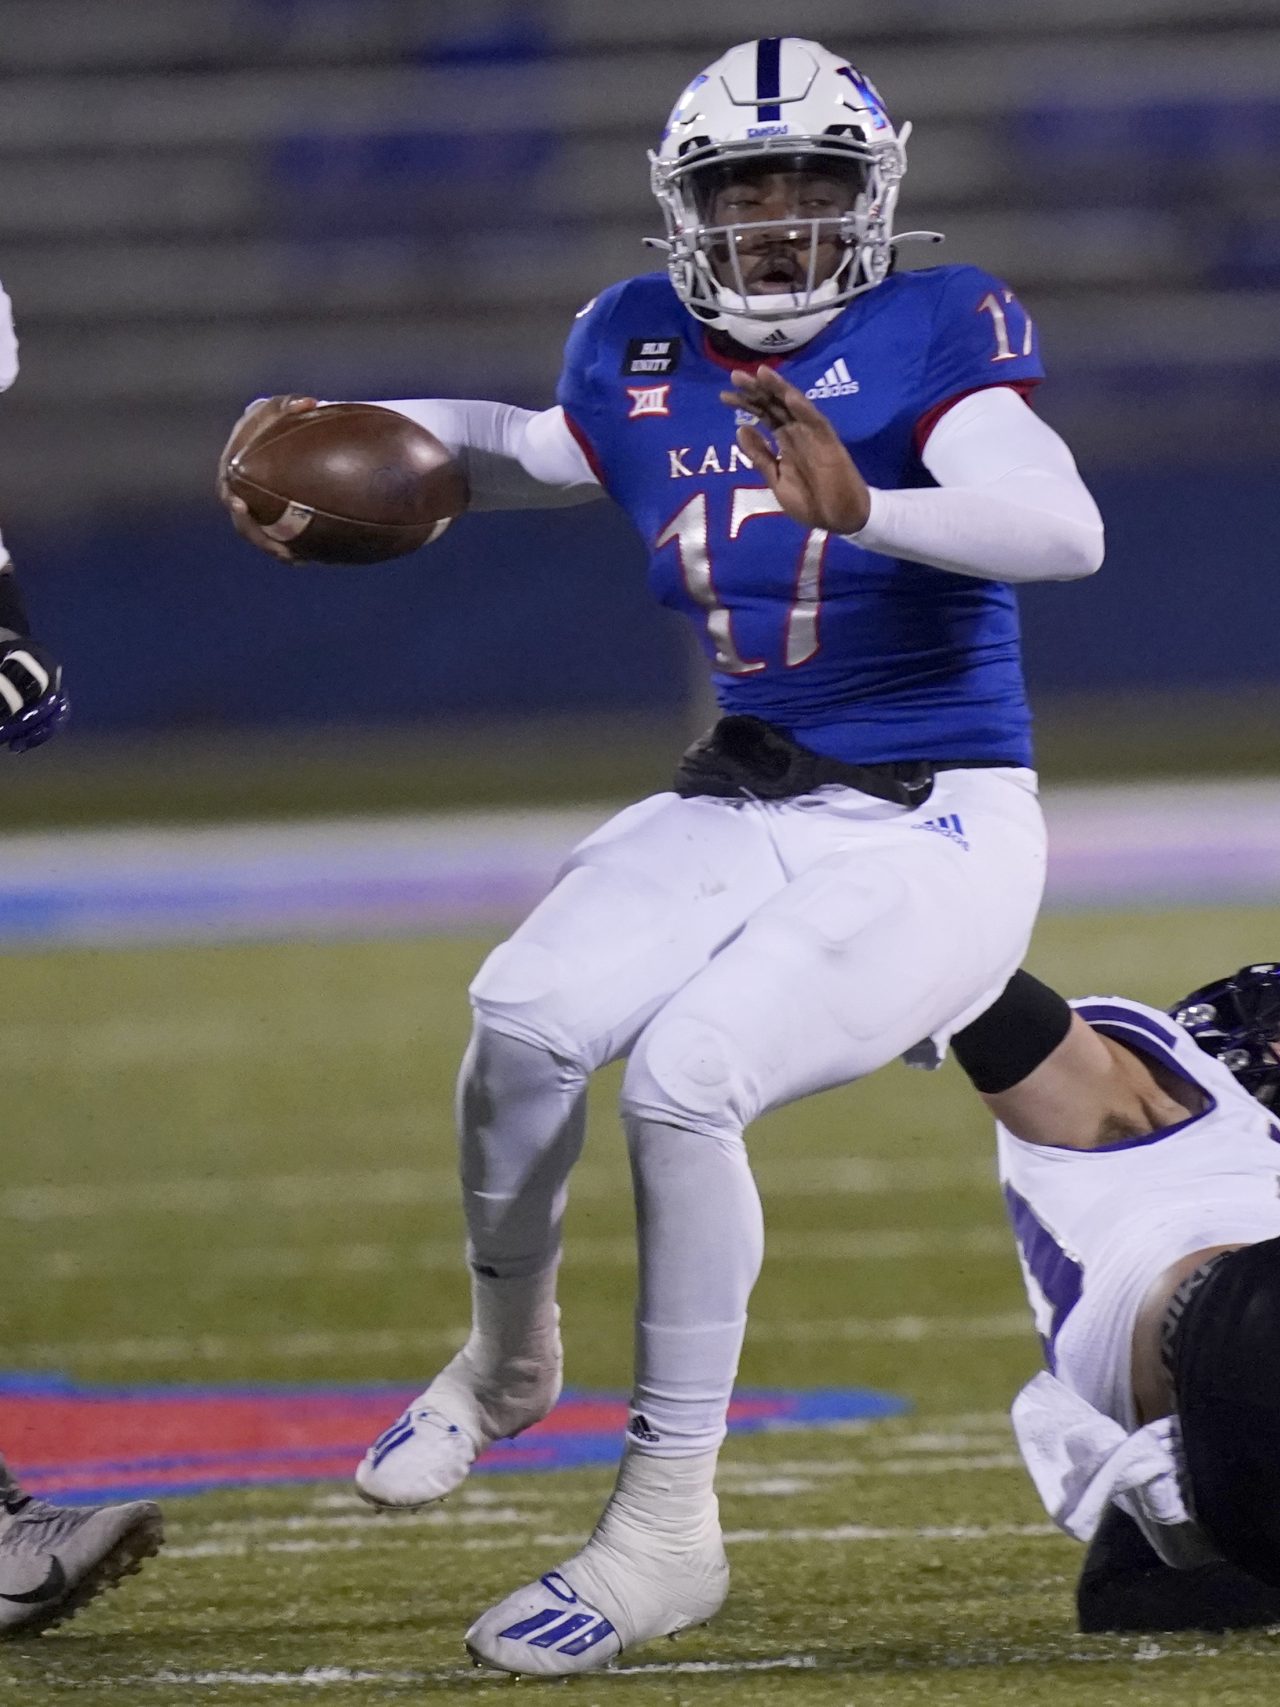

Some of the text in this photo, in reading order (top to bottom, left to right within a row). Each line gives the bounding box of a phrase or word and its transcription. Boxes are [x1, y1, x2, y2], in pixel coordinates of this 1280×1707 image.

[977, 289, 1033, 362] 17
[805, 381, 859, 400] adidas
[667, 440, 783, 479] KAN
[655, 486, 829, 676] 17
